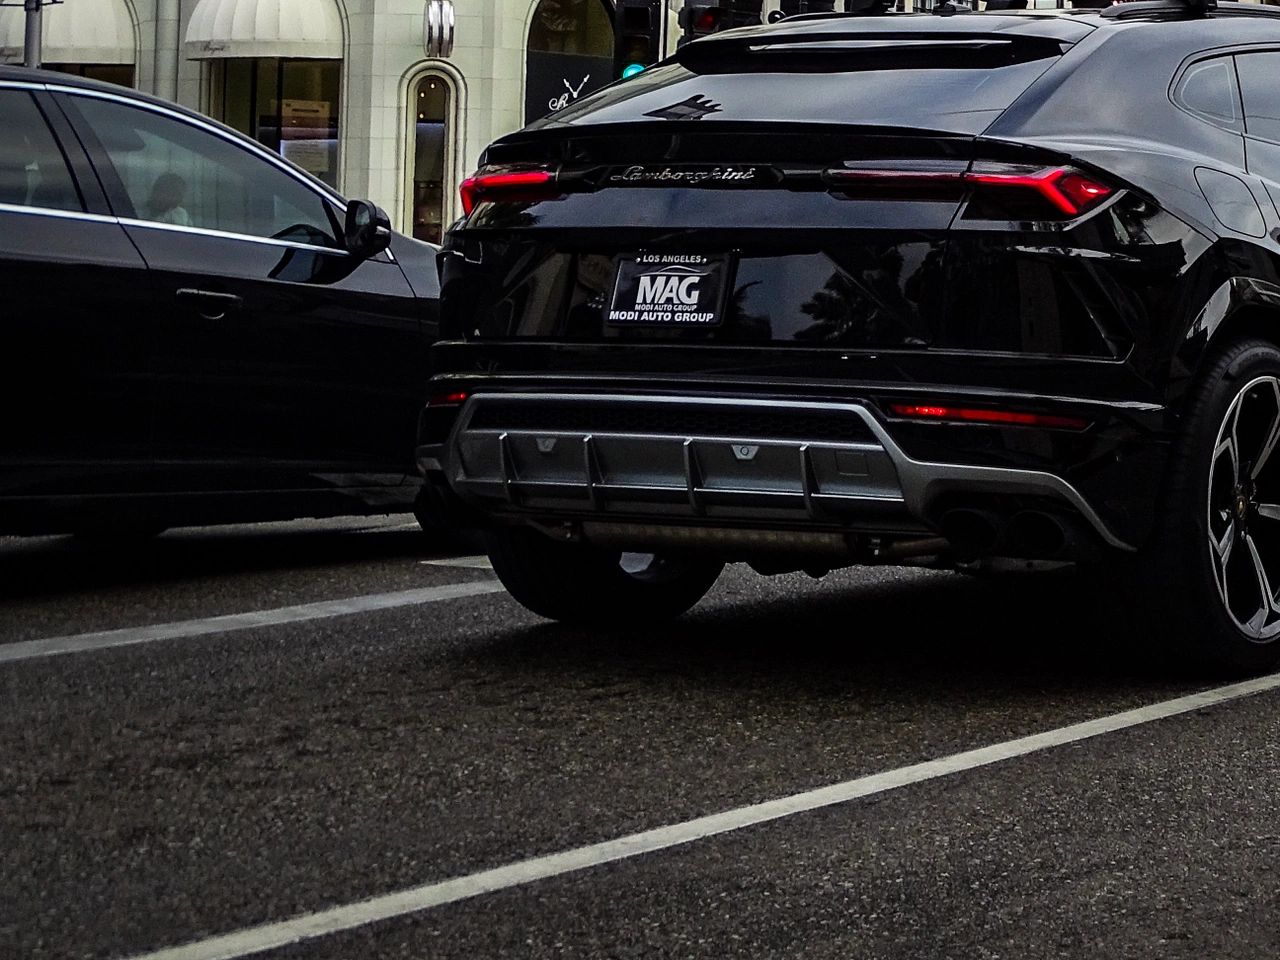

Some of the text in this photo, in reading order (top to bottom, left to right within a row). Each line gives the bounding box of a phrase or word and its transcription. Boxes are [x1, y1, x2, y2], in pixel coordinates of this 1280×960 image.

[610, 165, 756, 183] Lamborghini
[643, 255, 701, 263] LOS ANGELES
[636, 276, 700, 304] MAG
[609, 311, 714, 322] MODI AUTO GROUP
